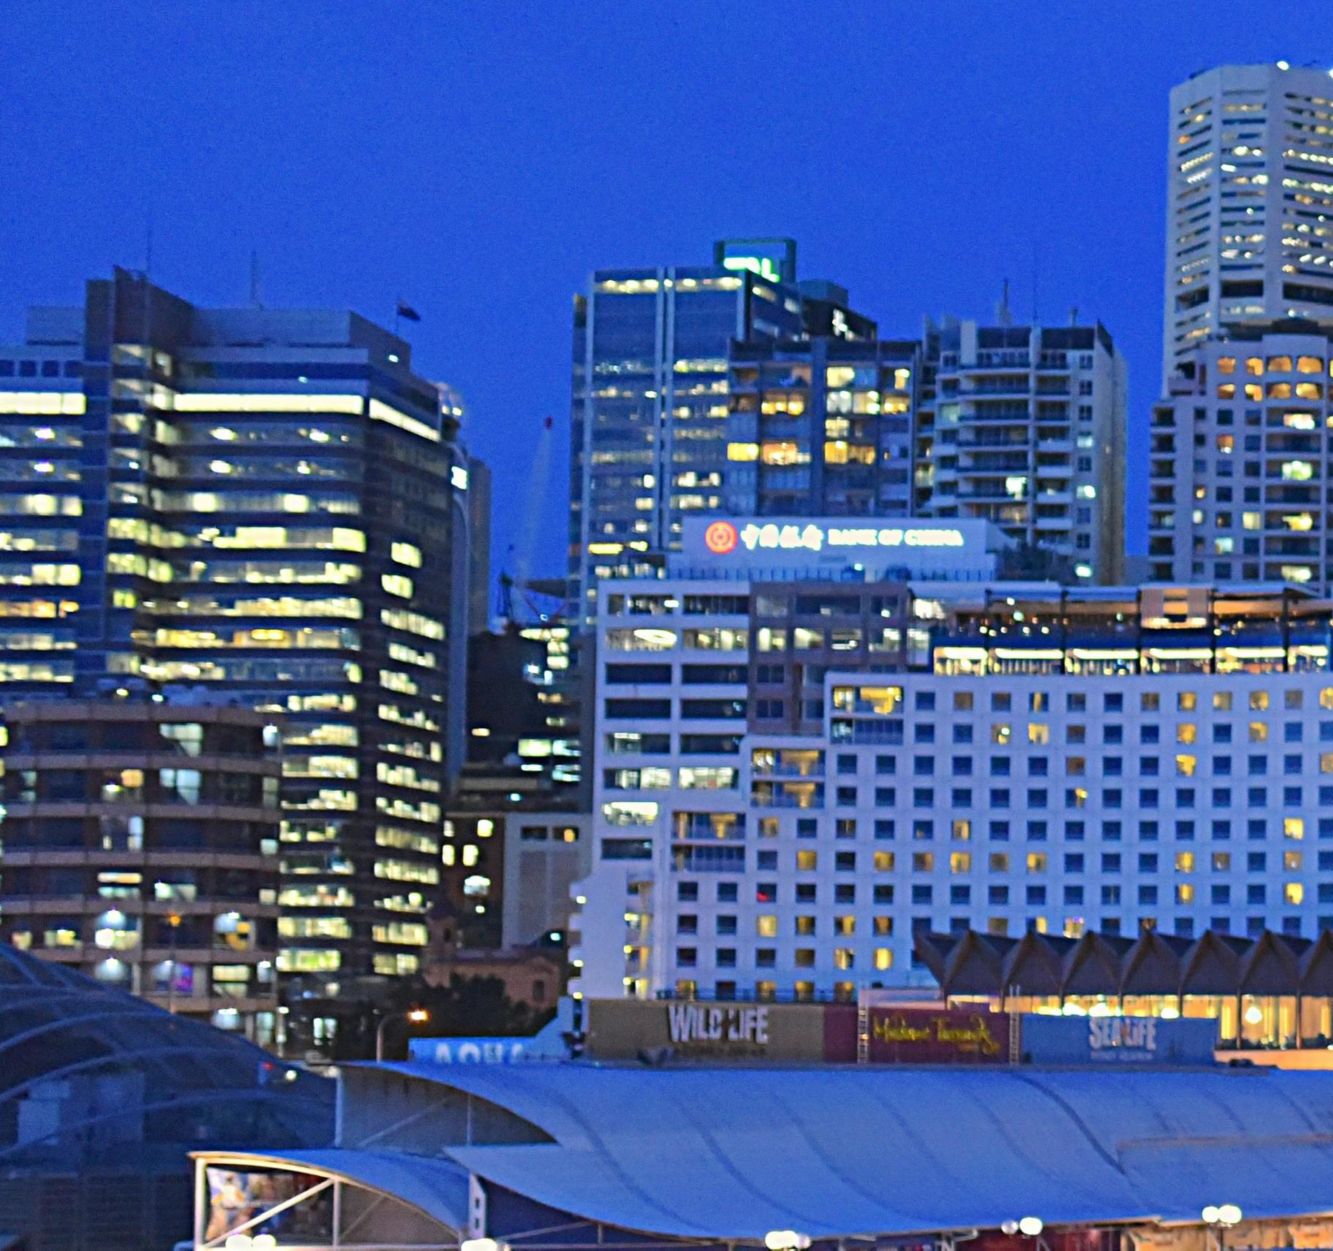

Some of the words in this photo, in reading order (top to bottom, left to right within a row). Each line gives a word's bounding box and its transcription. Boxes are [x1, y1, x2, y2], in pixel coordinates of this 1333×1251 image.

[828, 528, 877, 545] BANK
[878, 528, 903, 545] OF
[904, 529, 964, 546] CHINA
[668, 1003, 722, 1043] WILD
[727, 1005, 769, 1044] LIFE
[1089, 1017, 1121, 1050] SEA
[1124, 1017, 1157, 1051] LIFE
